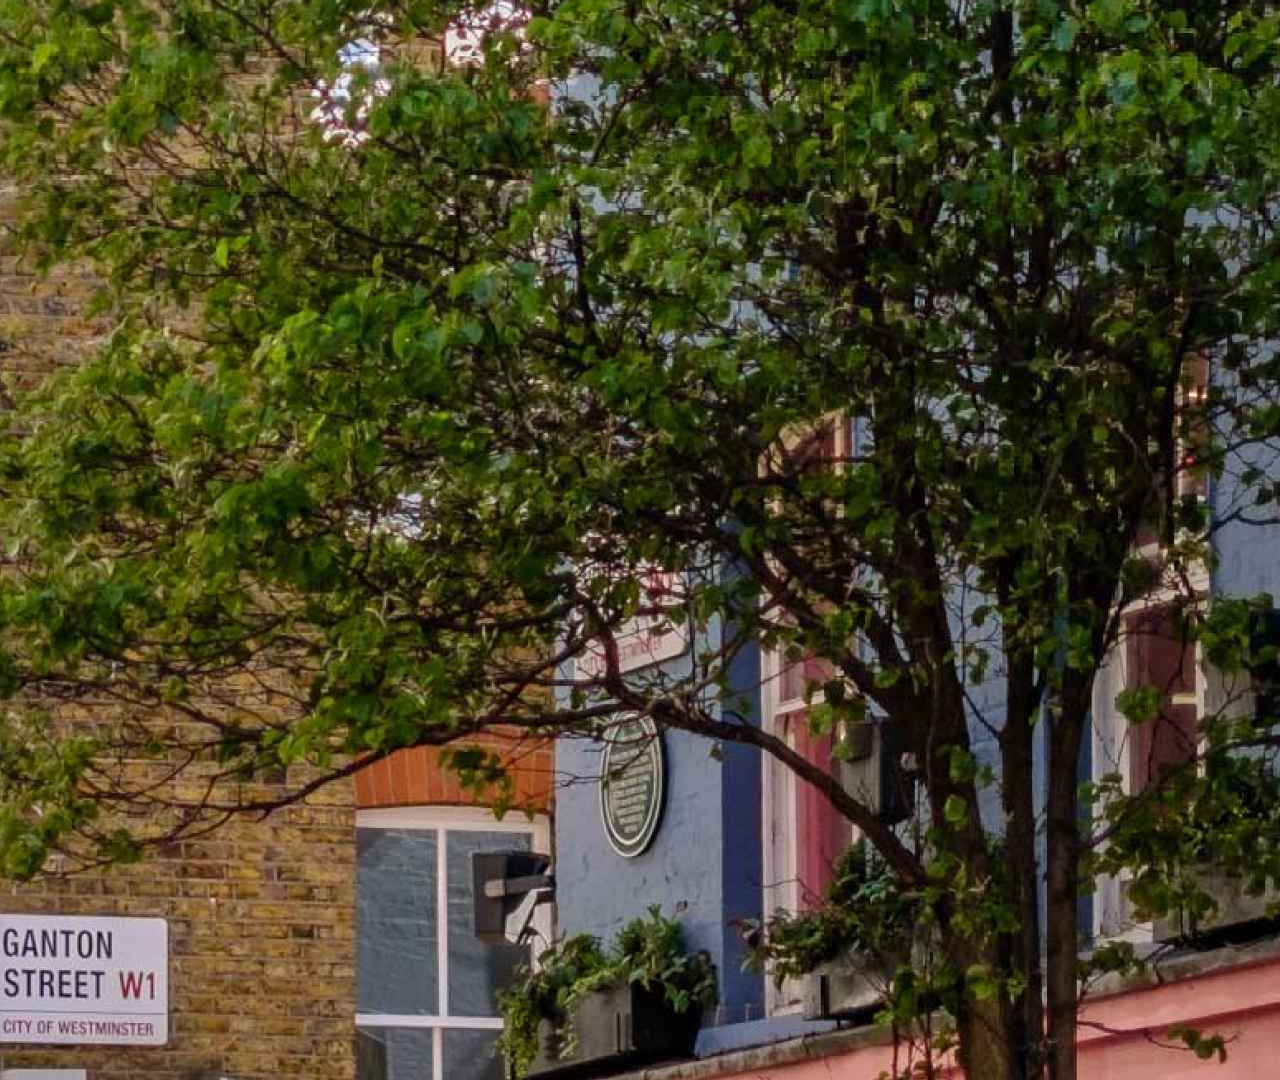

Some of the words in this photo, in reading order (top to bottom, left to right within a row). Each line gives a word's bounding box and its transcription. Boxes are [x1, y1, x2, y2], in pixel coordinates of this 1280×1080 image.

[2, 928, 113, 959] GANTON
[3, 968, 105, 999] STREET
[119, 971, 157, 1001] W1
[3, 1019, 32, 1035] CITY
[37, 1020, 54, 1035] OF
[58, 1020, 154, 1037] WESTMINSTER
